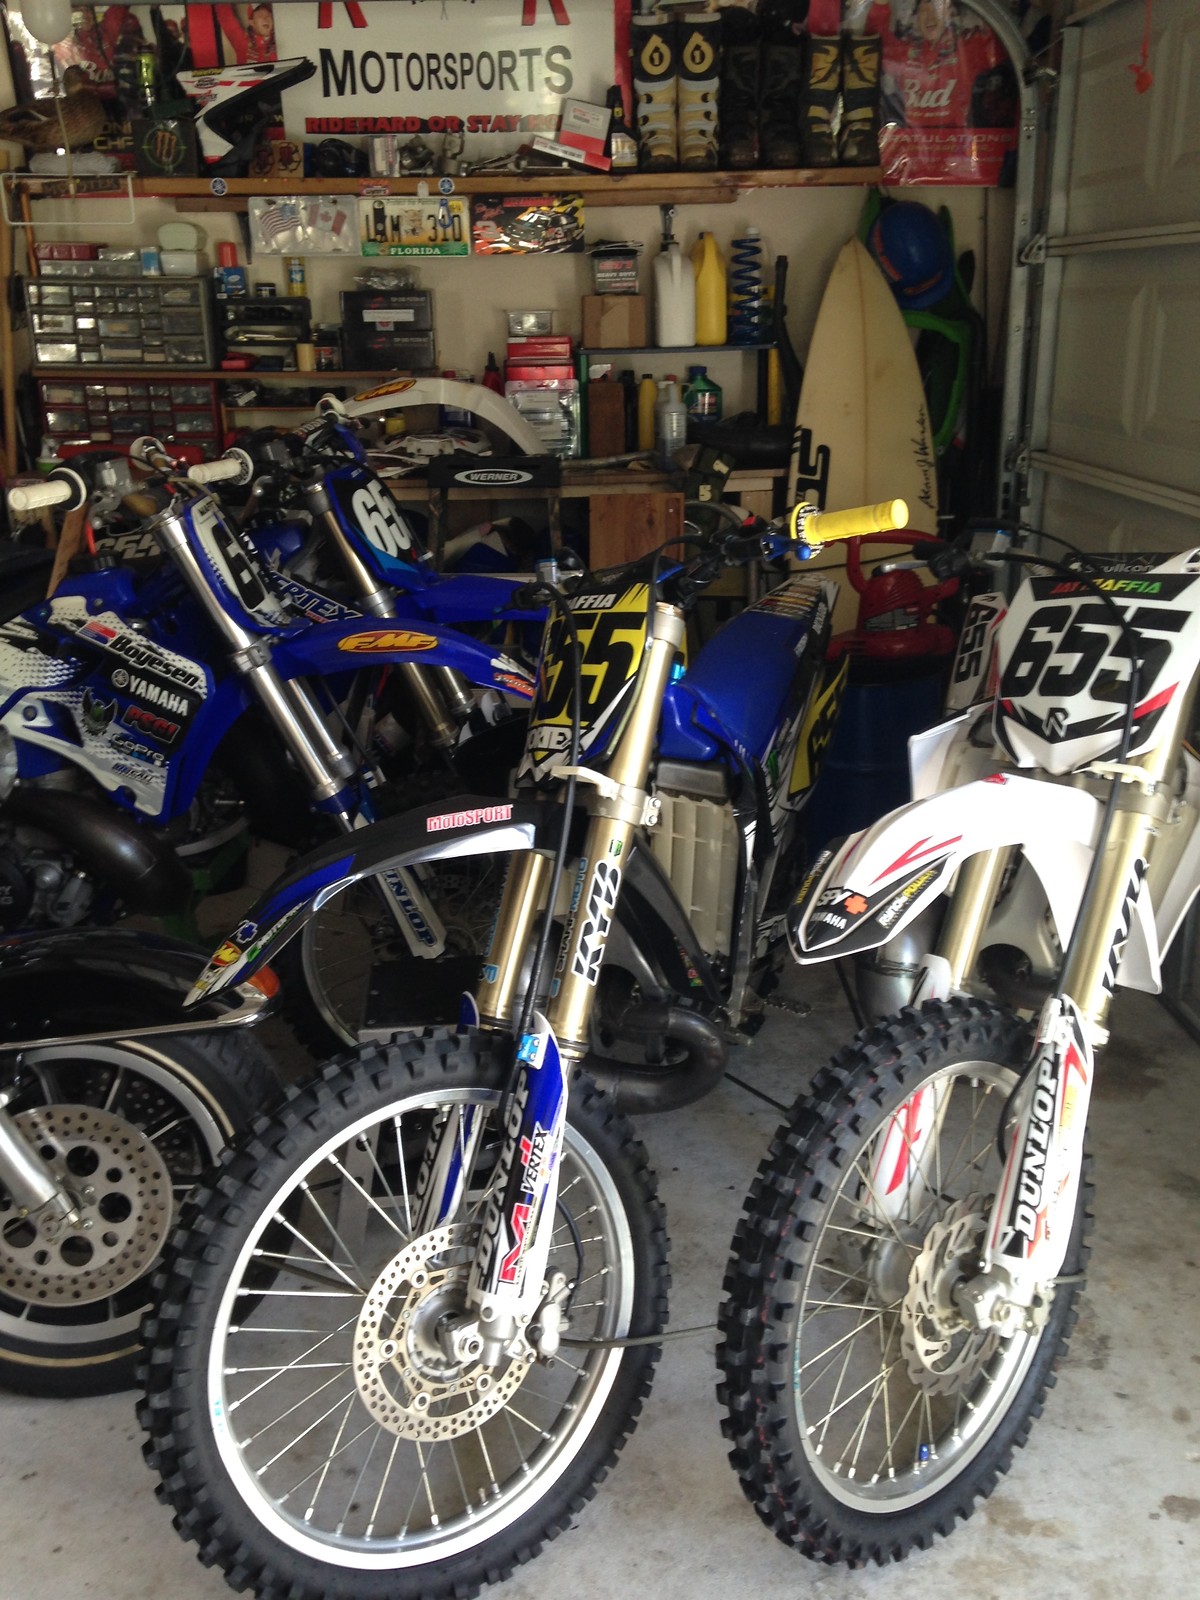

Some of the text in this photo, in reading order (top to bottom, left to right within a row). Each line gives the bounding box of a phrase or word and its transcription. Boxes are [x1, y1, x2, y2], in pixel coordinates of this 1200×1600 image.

[318, 45, 574, 97] MOTORSPORTS
[903, 78, 958, 109] Bud
[305, 116, 421, 134] RIDEHARD
[429, 116, 465, 133] OR
[466, 115, 521, 133] STAY
[389, 246, 441, 255] FLORIDA
[469, 472, 519, 482] WERNER
[567, 593, 618, 610] AFFIA
[338, 632, 438, 652] FMF
[1001, 603, 1193, 705] 655
[107, 634, 202, 691] Boyesen
[128, 674, 189, 717] YAMAHA
[520, 1125, 549, 1194] VERTEX
[1013, 1056, 1059, 1242] DUNLOP
